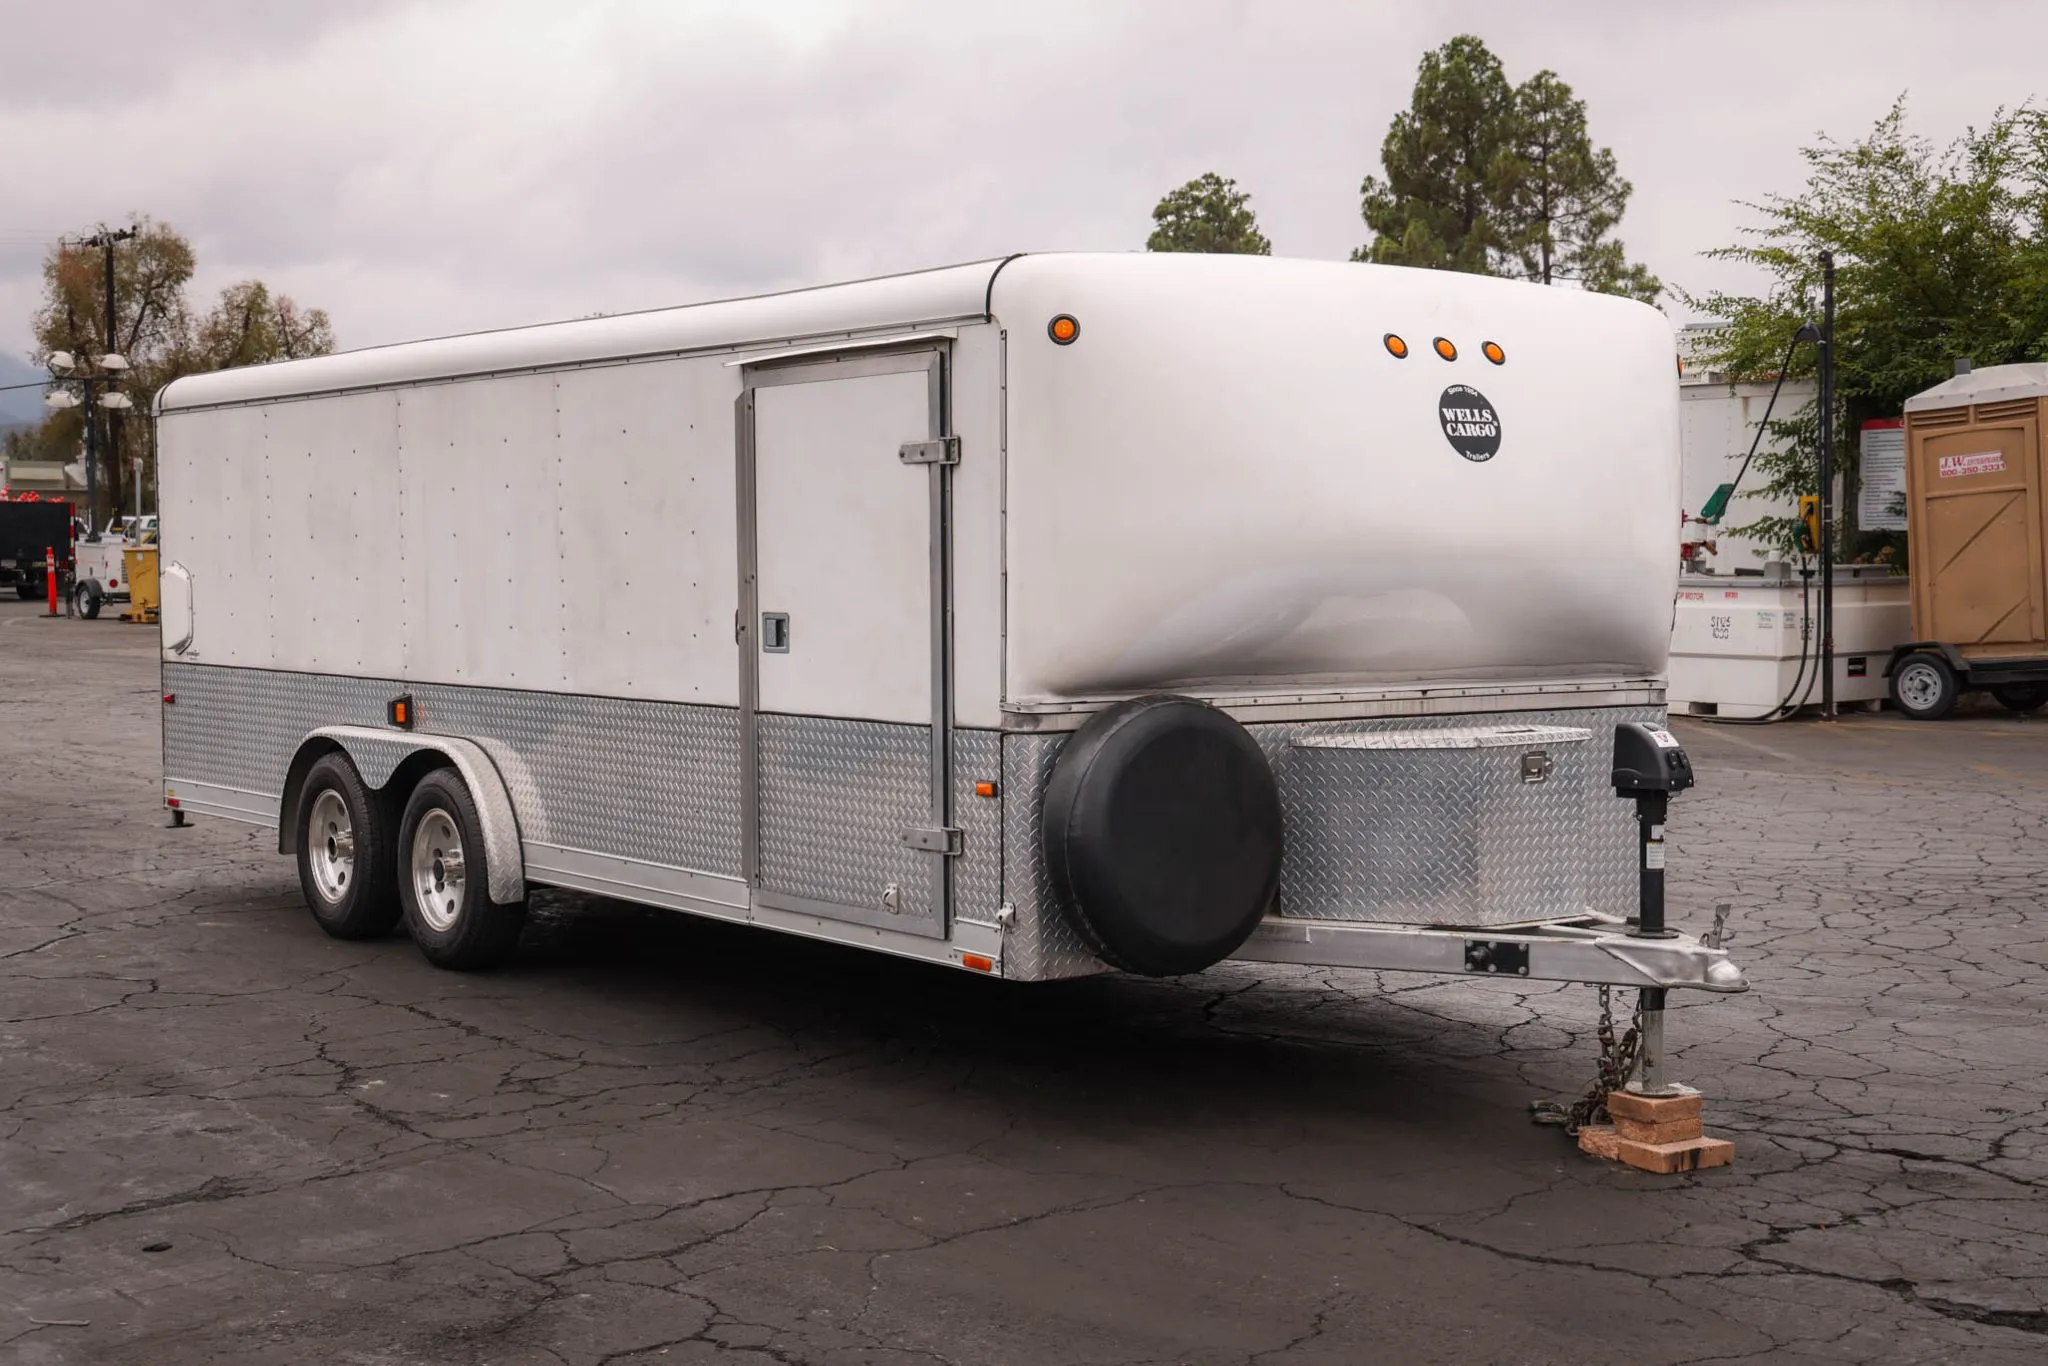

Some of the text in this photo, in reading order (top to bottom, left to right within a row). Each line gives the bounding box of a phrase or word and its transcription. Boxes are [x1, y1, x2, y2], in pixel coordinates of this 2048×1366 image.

[1441, 408, 1493, 422] WELLS
[1446, 423, 1496, 436] CARGO
[1466, 451, 1490, 461] Trailers
